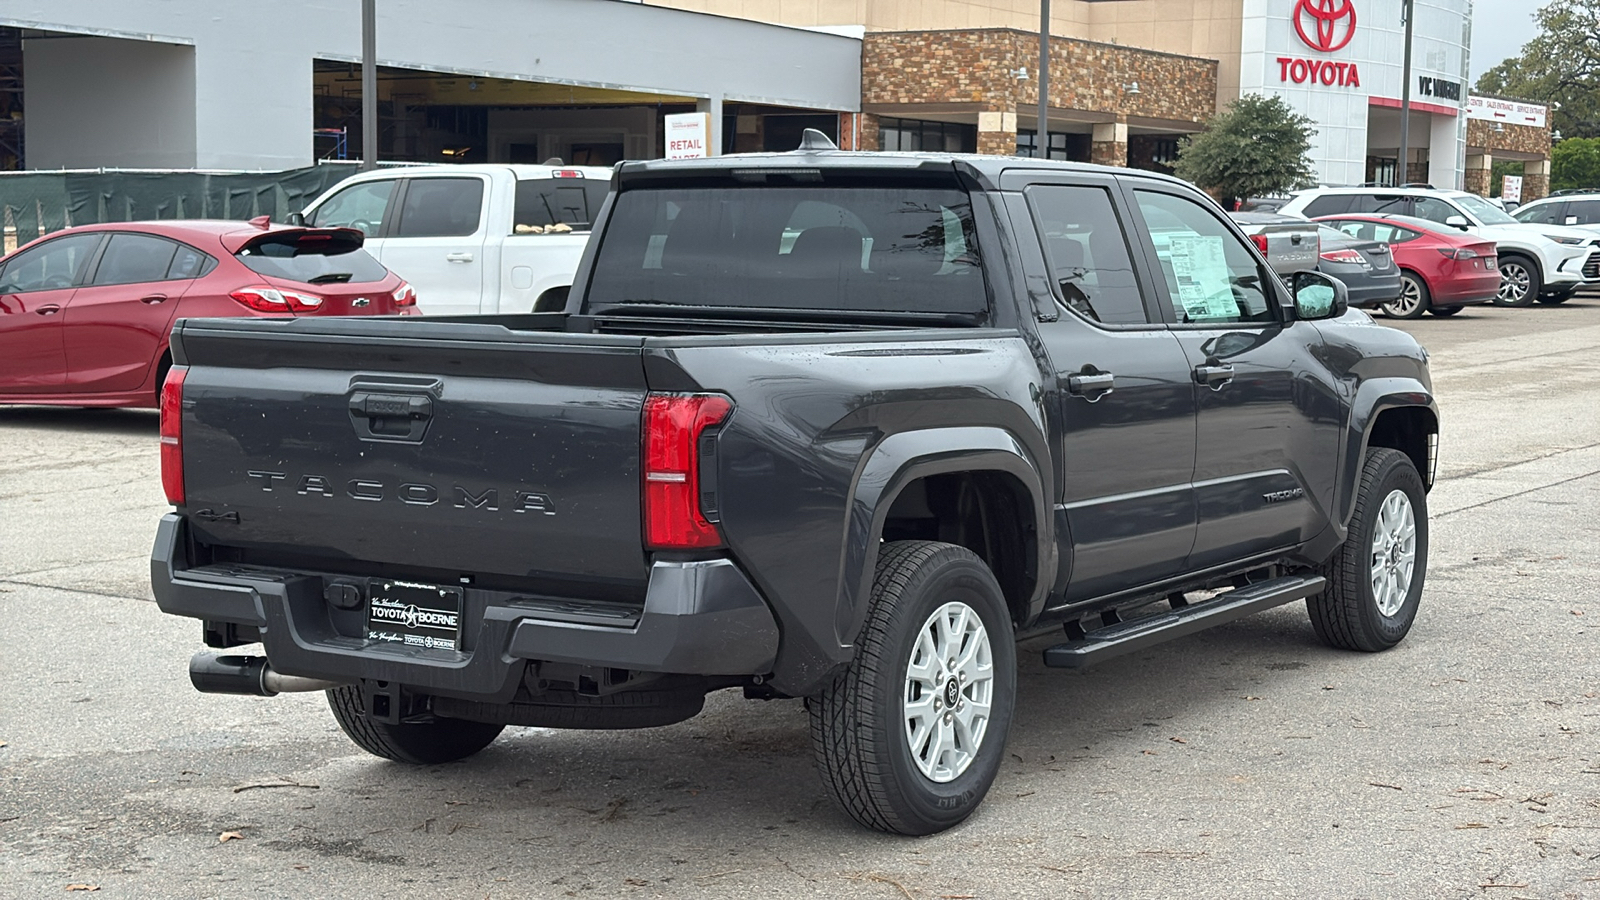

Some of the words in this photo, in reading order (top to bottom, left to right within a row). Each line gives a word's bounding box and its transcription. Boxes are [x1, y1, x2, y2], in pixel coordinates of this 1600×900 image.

[1276, 57, 1360, 87] TOYOTA
[1419, 75, 1432, 96] VIC
[670, 139, 702, 151] RETAIL
[1276, 253, 1313, 261] TACOMA
[247, 469, 556, 515] TACOMA
[1262, 487, 1304, 502] TACOMA
[371, 606, 406, 620] TOYOTA
[419, 611, 458, 626] BOERNE
[404, 636, 425, 645] TOYOTA
[433, 639, 455, 649] BOERNE
